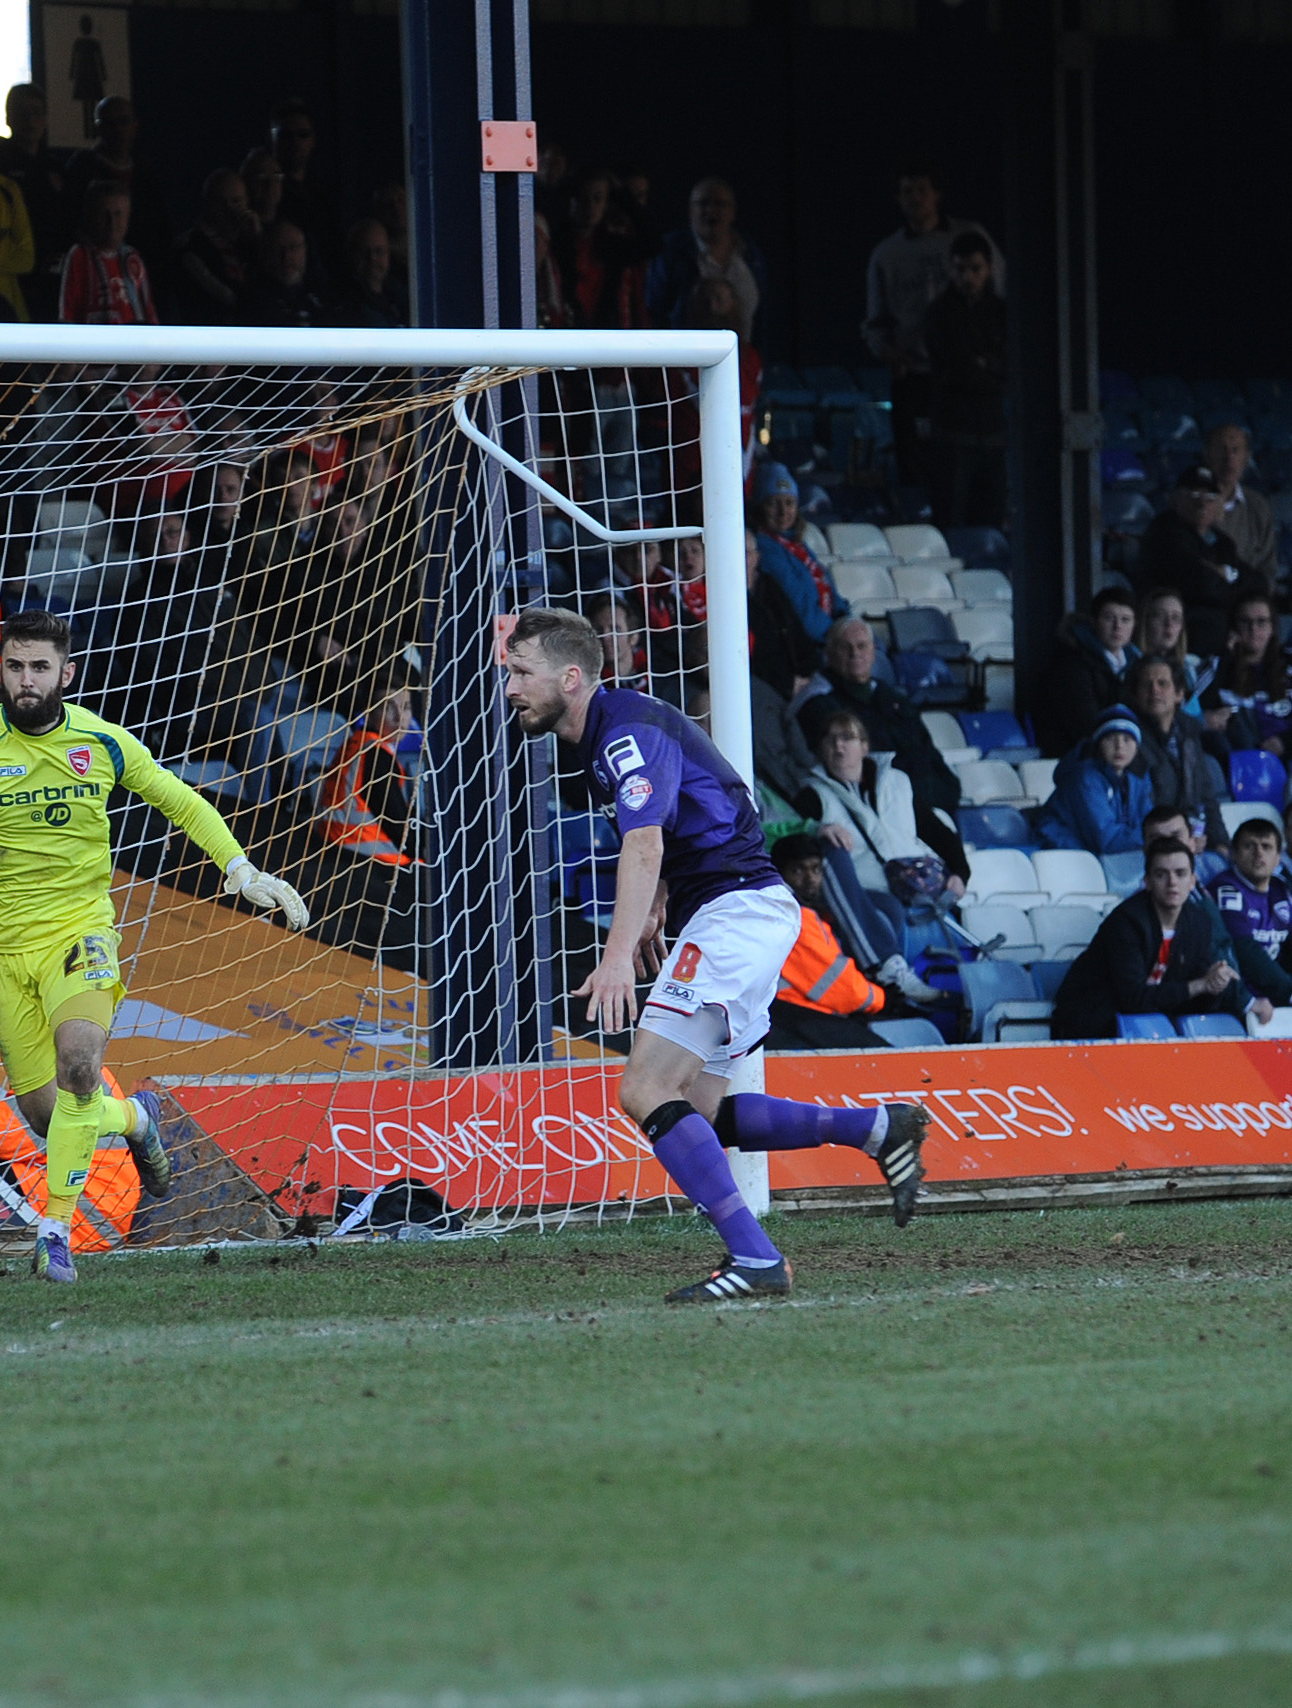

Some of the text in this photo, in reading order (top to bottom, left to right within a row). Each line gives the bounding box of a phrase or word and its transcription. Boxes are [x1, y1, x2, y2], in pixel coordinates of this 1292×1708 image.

[47, 807, 69, 822] JD
[64, 935, 109, 978] 25
[672, 942, 702, 983] 8
[664, 984, 692, 999] FILA
[1104, 1104, 1175, 1132] we
[332, 1107, 655, 1176] COME ON
